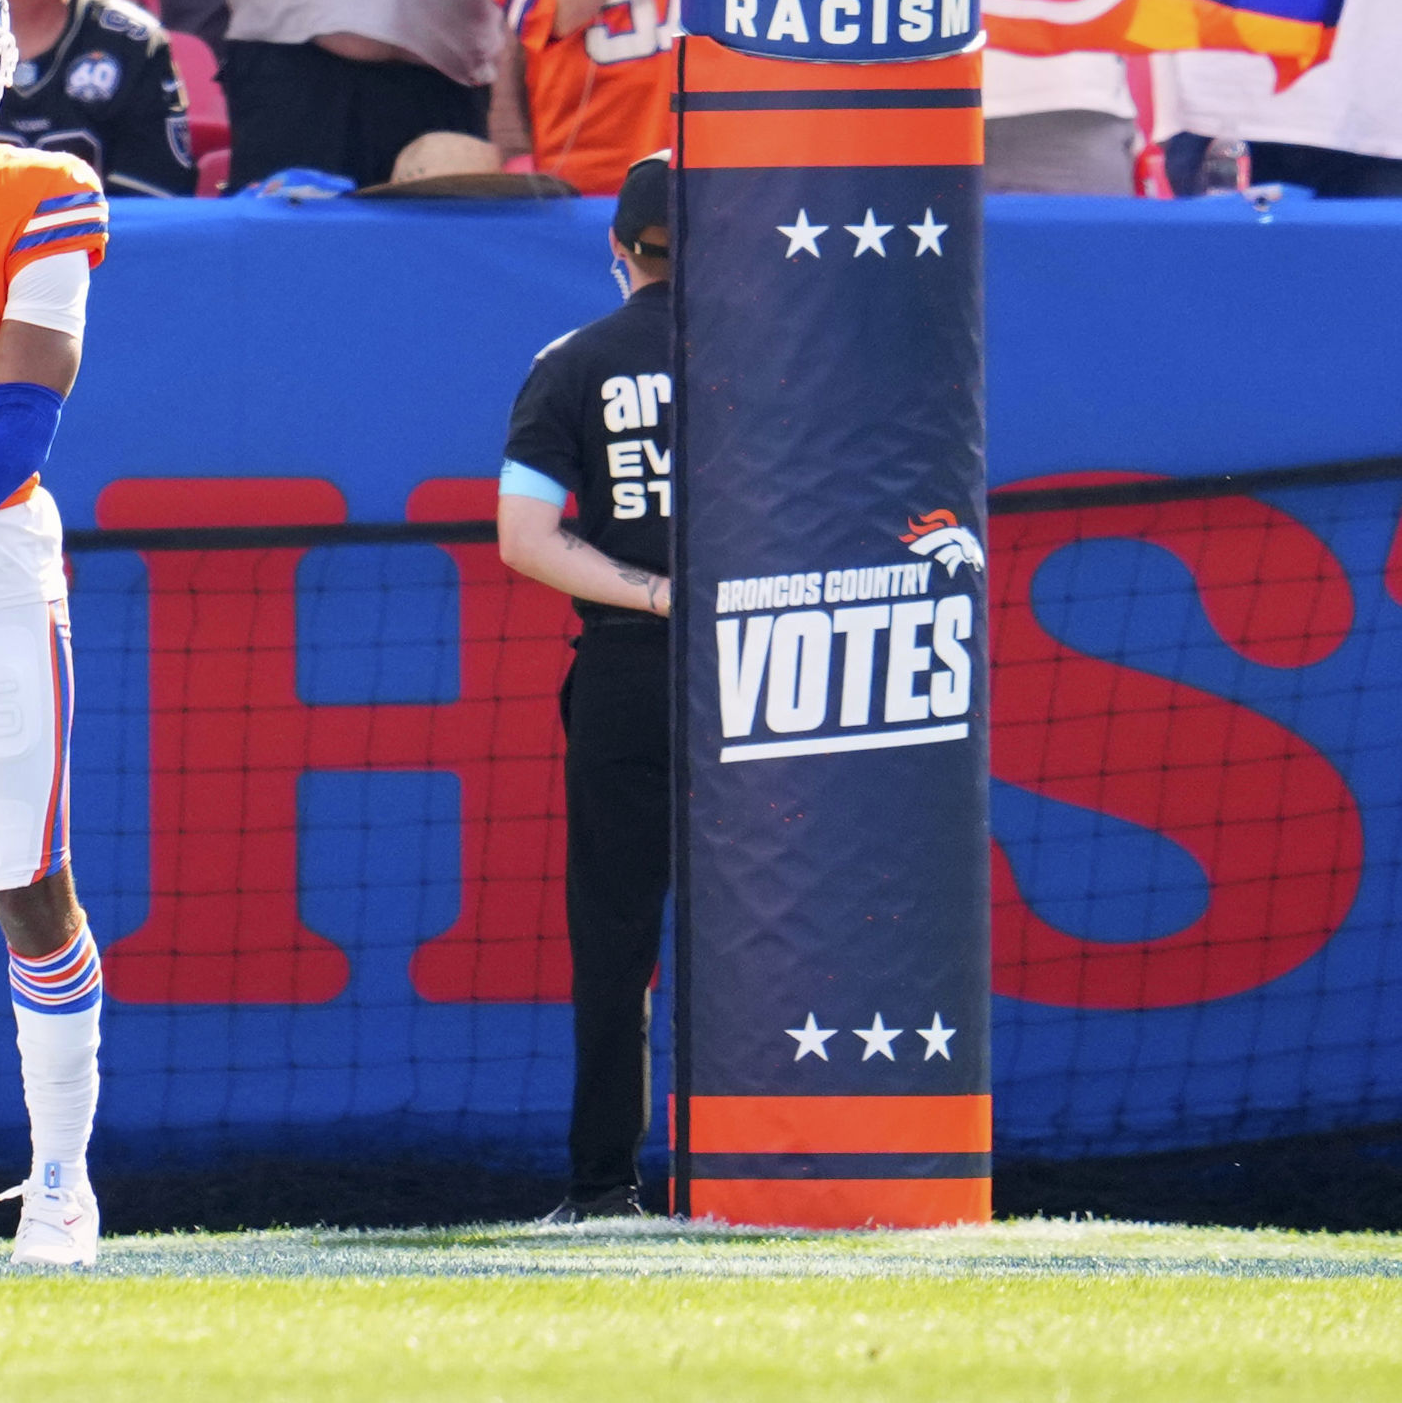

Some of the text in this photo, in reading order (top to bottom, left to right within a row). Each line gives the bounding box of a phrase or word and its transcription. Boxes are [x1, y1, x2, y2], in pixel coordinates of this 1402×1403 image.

[601, 373, 672, 433] ar
[606, 439, 671, 478] EV
[612, 480, 671, 520] ST
[716, 561, 932, 614] BRONCOS COUNTRY
[716, 594, 972, 738] VOTES
[989, 470, 1402, 1011] S
